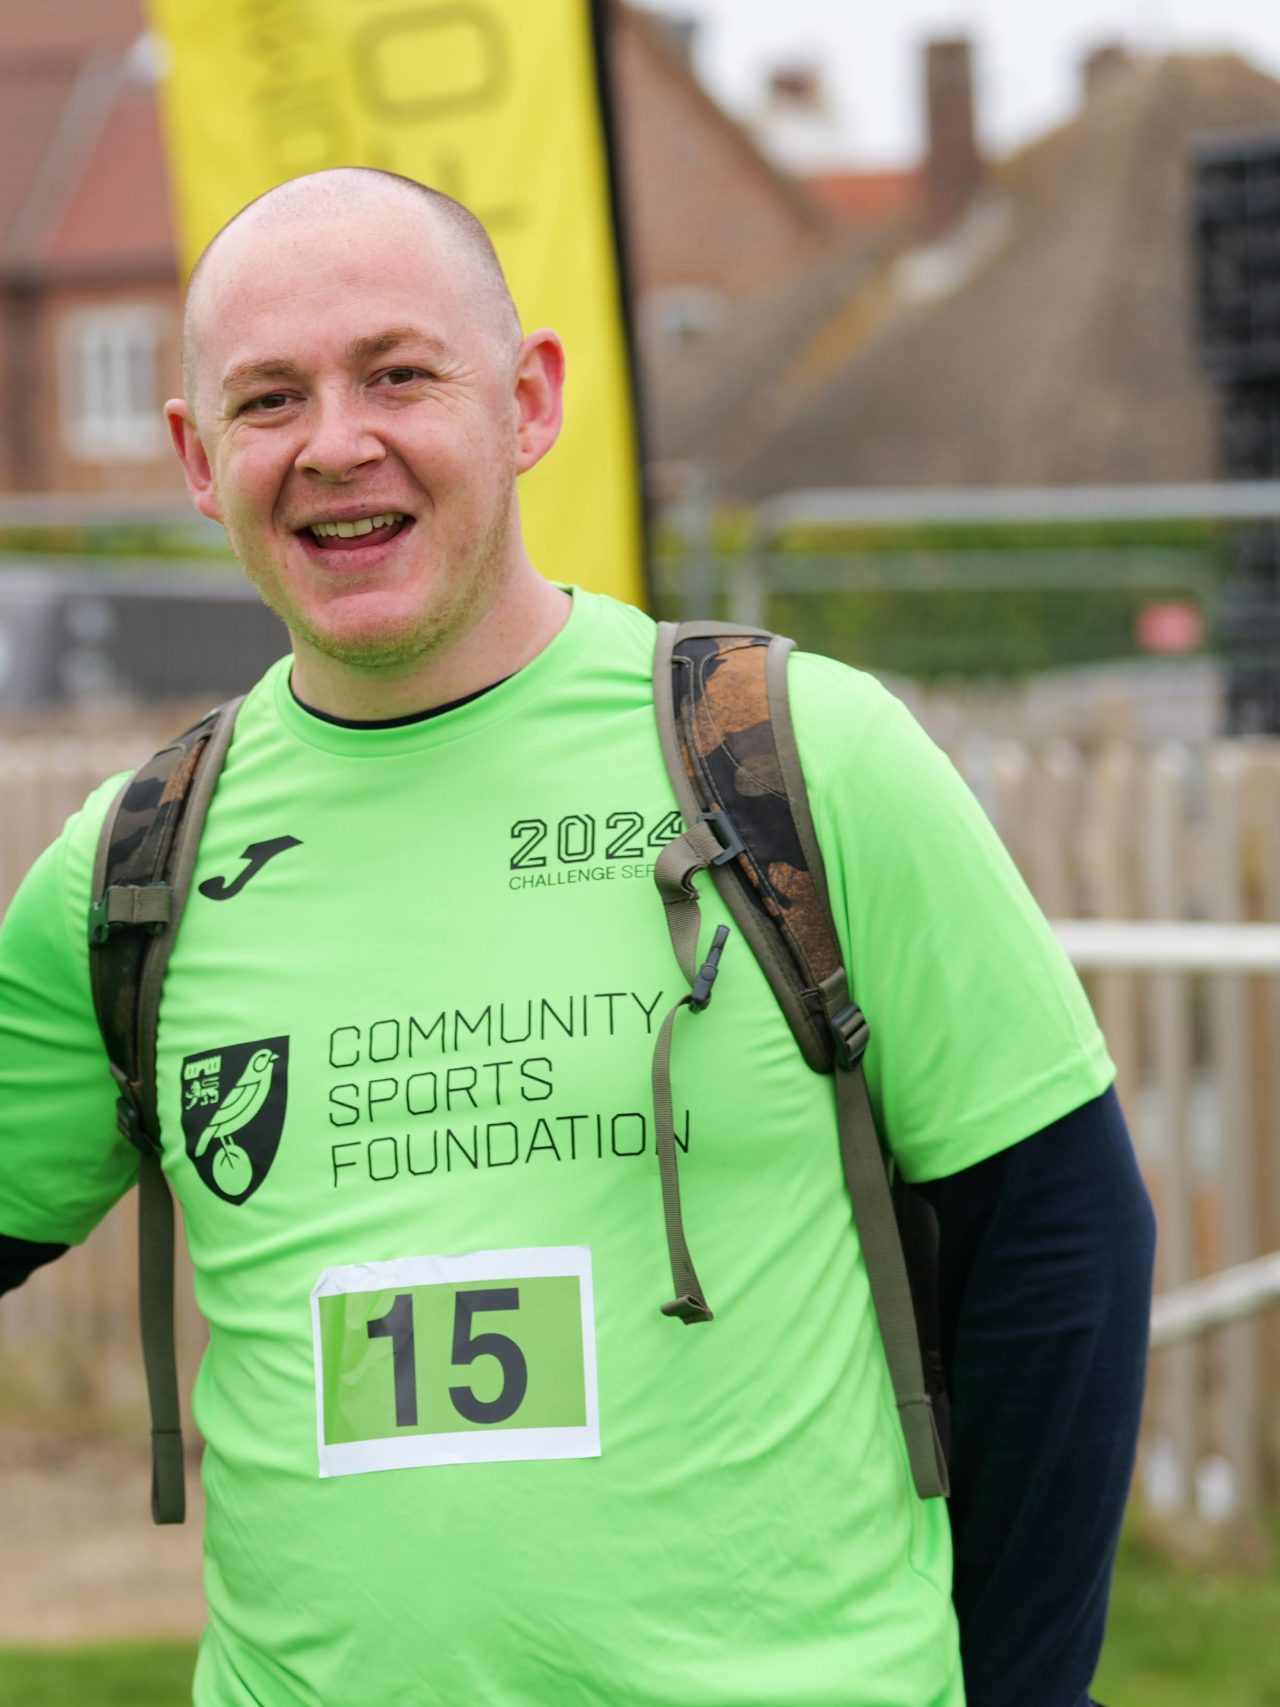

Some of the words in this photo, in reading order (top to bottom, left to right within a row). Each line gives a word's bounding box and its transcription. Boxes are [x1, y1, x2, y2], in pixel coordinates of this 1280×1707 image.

[510, 811, 682, 871] 2024
[509, 867, 617, 891] CHALLENGE
[328, 990, 664, 1070] COMMUNITY
[329, 1057, 553, 1128] SPORTS
[366, 1288, 527, 1424] 15
